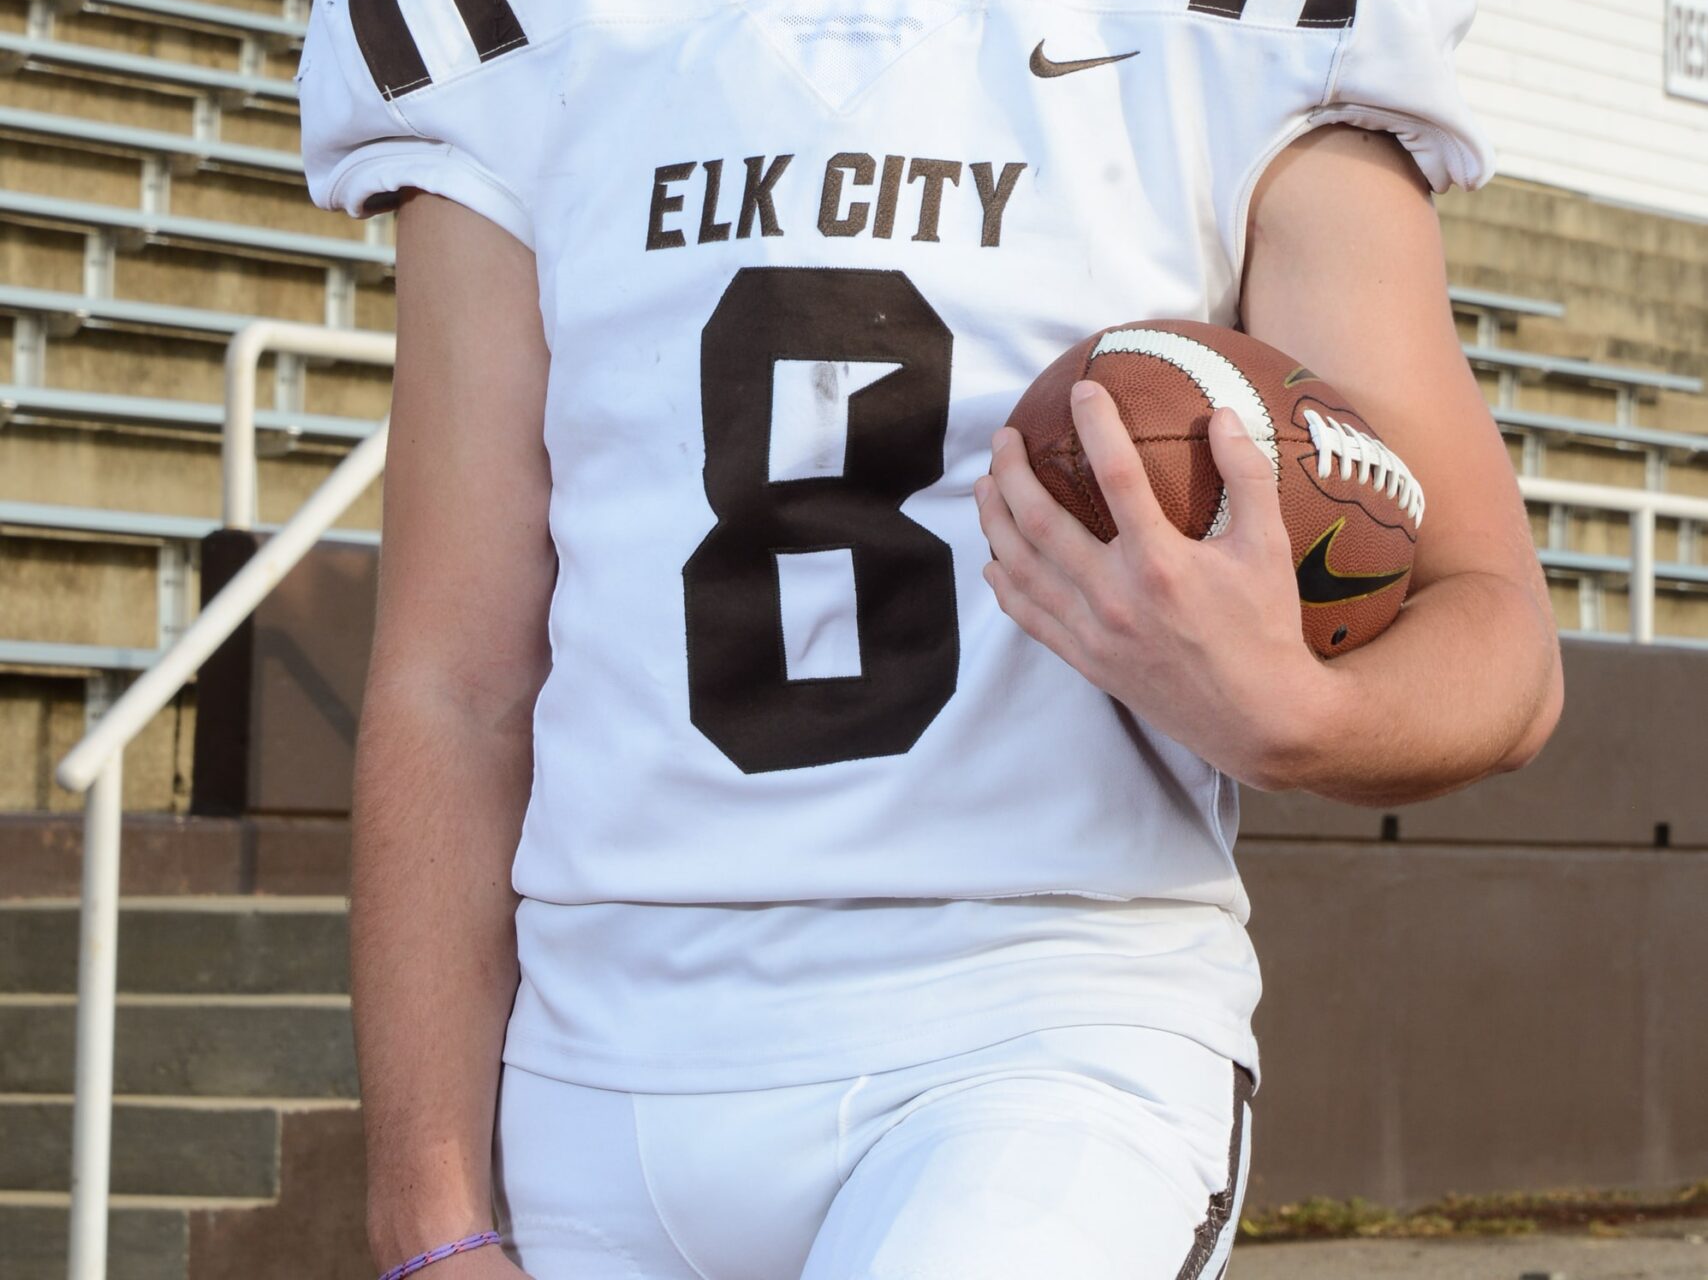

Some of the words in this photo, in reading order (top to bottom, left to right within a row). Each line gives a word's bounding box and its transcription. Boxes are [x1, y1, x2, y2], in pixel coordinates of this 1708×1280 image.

[646, 153, 795, 251] ELK
[816, 152, 1028, 248] CITY
[682, 266, 960, 775] 8
